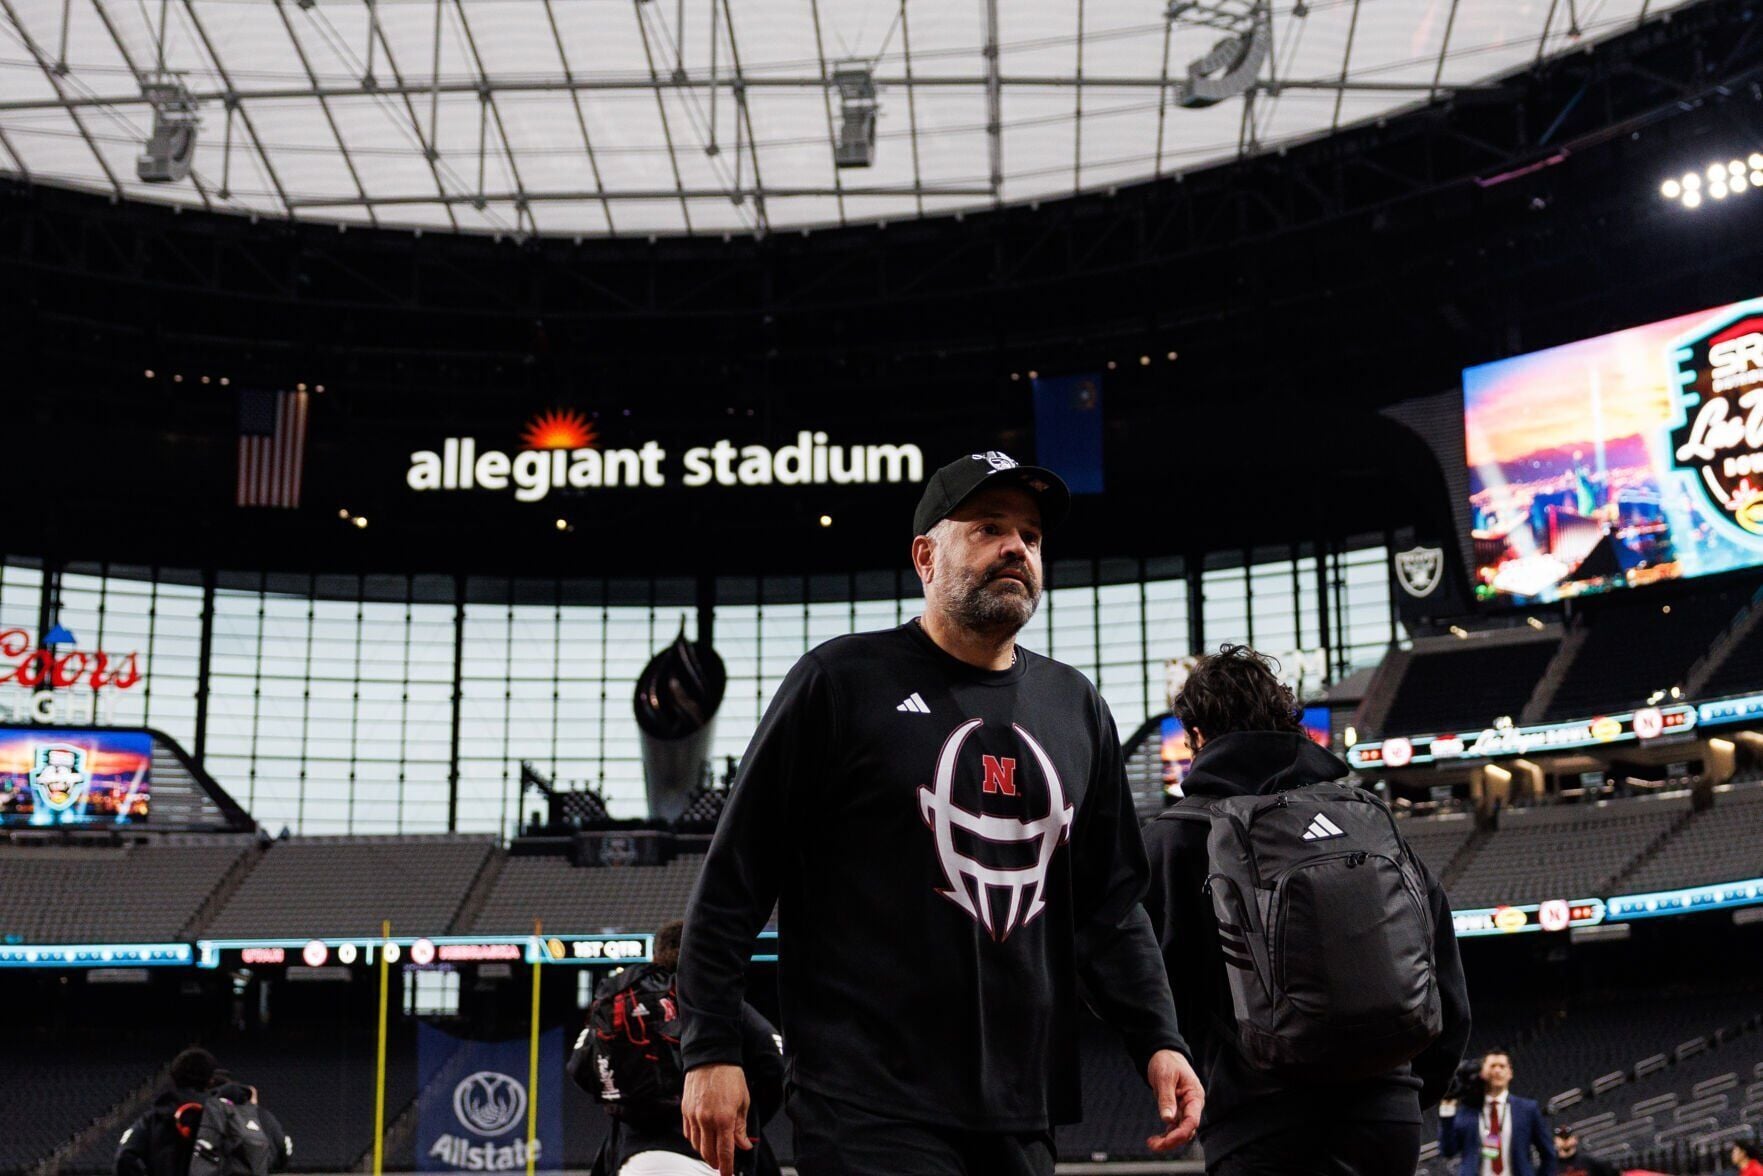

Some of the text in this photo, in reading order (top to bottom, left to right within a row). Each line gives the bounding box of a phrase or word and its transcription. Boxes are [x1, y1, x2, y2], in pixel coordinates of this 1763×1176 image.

[407, 431, 923, 501] allegiant stadium
[0, 628, 142, 689] Coors
[982, 754, 1016, 796] N
[603, 940, 642, 960] QTR
[429, 1133, 542, 1171] Allstate
